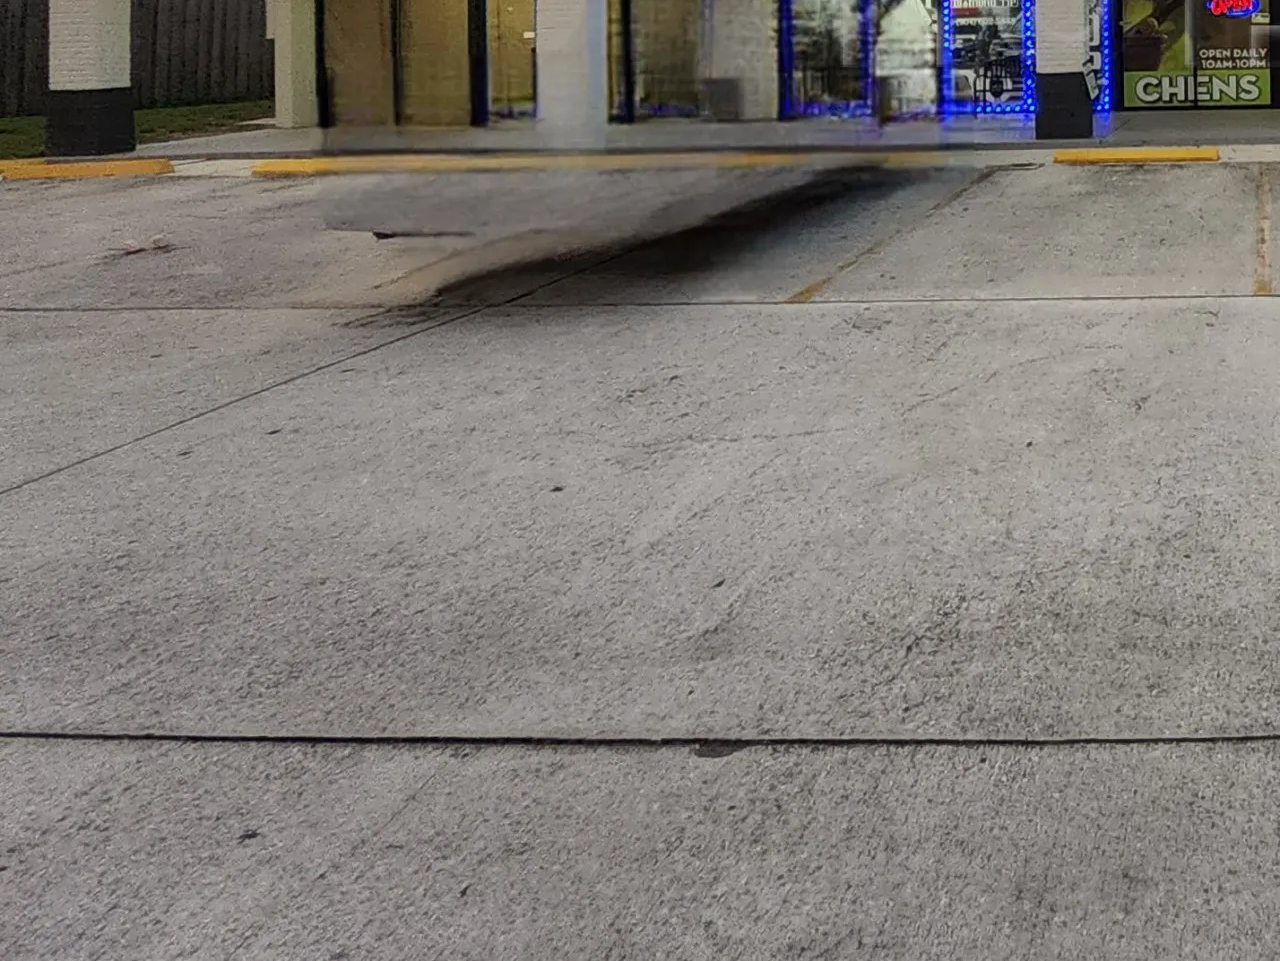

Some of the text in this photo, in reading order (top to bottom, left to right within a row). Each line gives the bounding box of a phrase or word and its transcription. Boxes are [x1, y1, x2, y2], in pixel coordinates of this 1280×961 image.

[1199, 47, 1268, 58] OPEN DAILY
[1201, 58, 1267, 69] 10AM-10PM
[1134, 74, 1261, 103] CHENS
